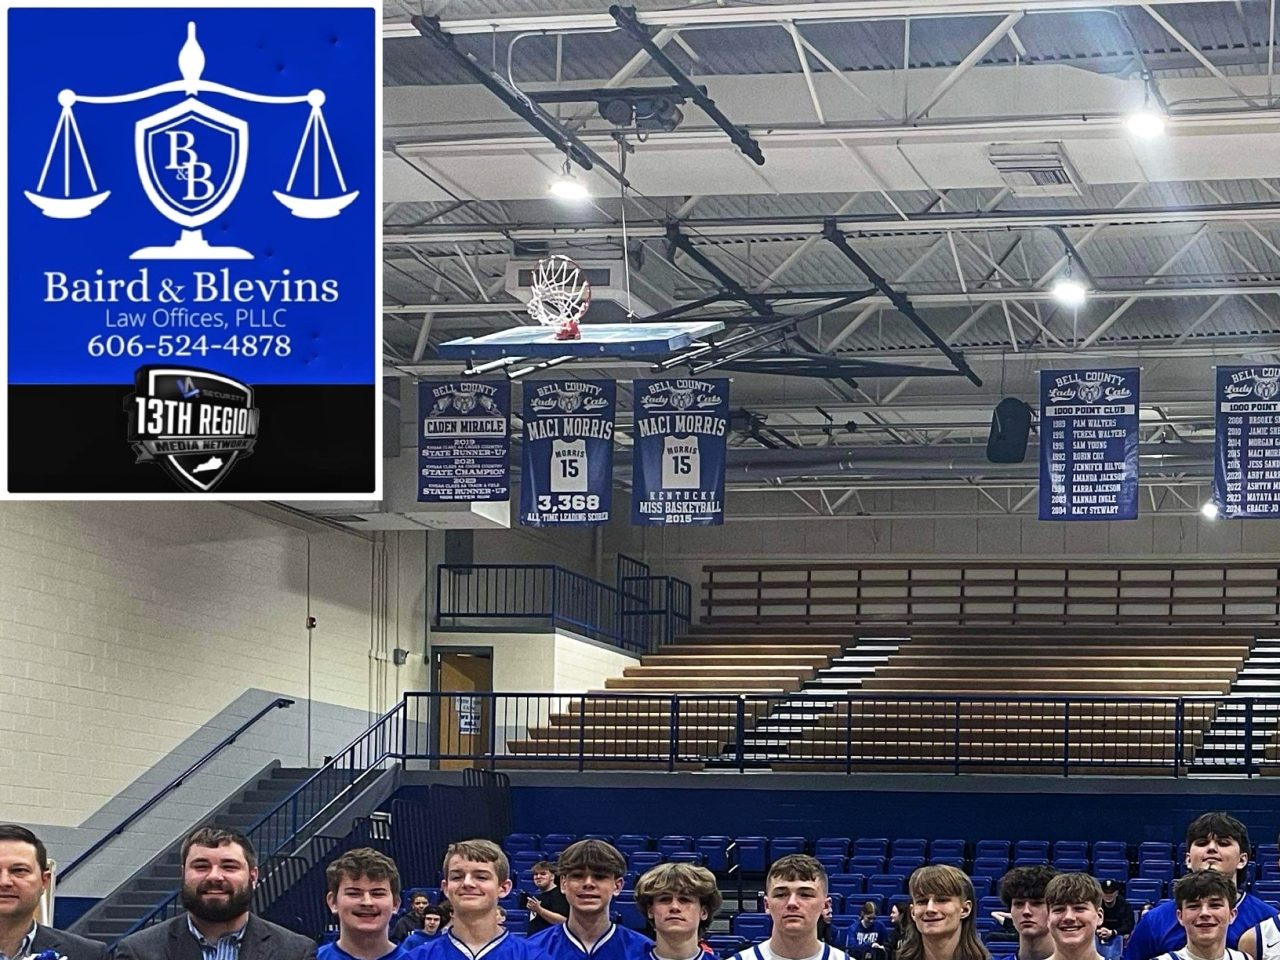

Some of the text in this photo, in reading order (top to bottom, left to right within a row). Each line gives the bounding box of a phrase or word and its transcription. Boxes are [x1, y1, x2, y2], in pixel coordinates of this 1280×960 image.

[1055, 371, 1125, 387] BELL COUNTY
[1232, 370, 1256, 383] BELL
[433, 382, 498, 397] BELL COUNTY
[537, 382, 601, 397] BELL COUNTY
[648, 379, 715, 394] BELL COUNTY
[1251, 403, 1277, 411] POINT
[427, 420, 503, 433] CADEN MIRACLE
[527, 420, 613, 440] MACI MORRIS
[638, 416, 726, 438] MACI MORRIS
[555, 450, 585, 458] MORRIS
[667, 446, 699, 455] MORRIS
[560, 459, 579, 478] 15
[673, 456, 691, 475] 15
[538, 496, 599, 513] 3,368
[640, 501, 721, 514] MISS BASKETBALL
[527, 512, 584, 522] ALL-TIME LEADING
[666, 514, 692, 523] 2015
